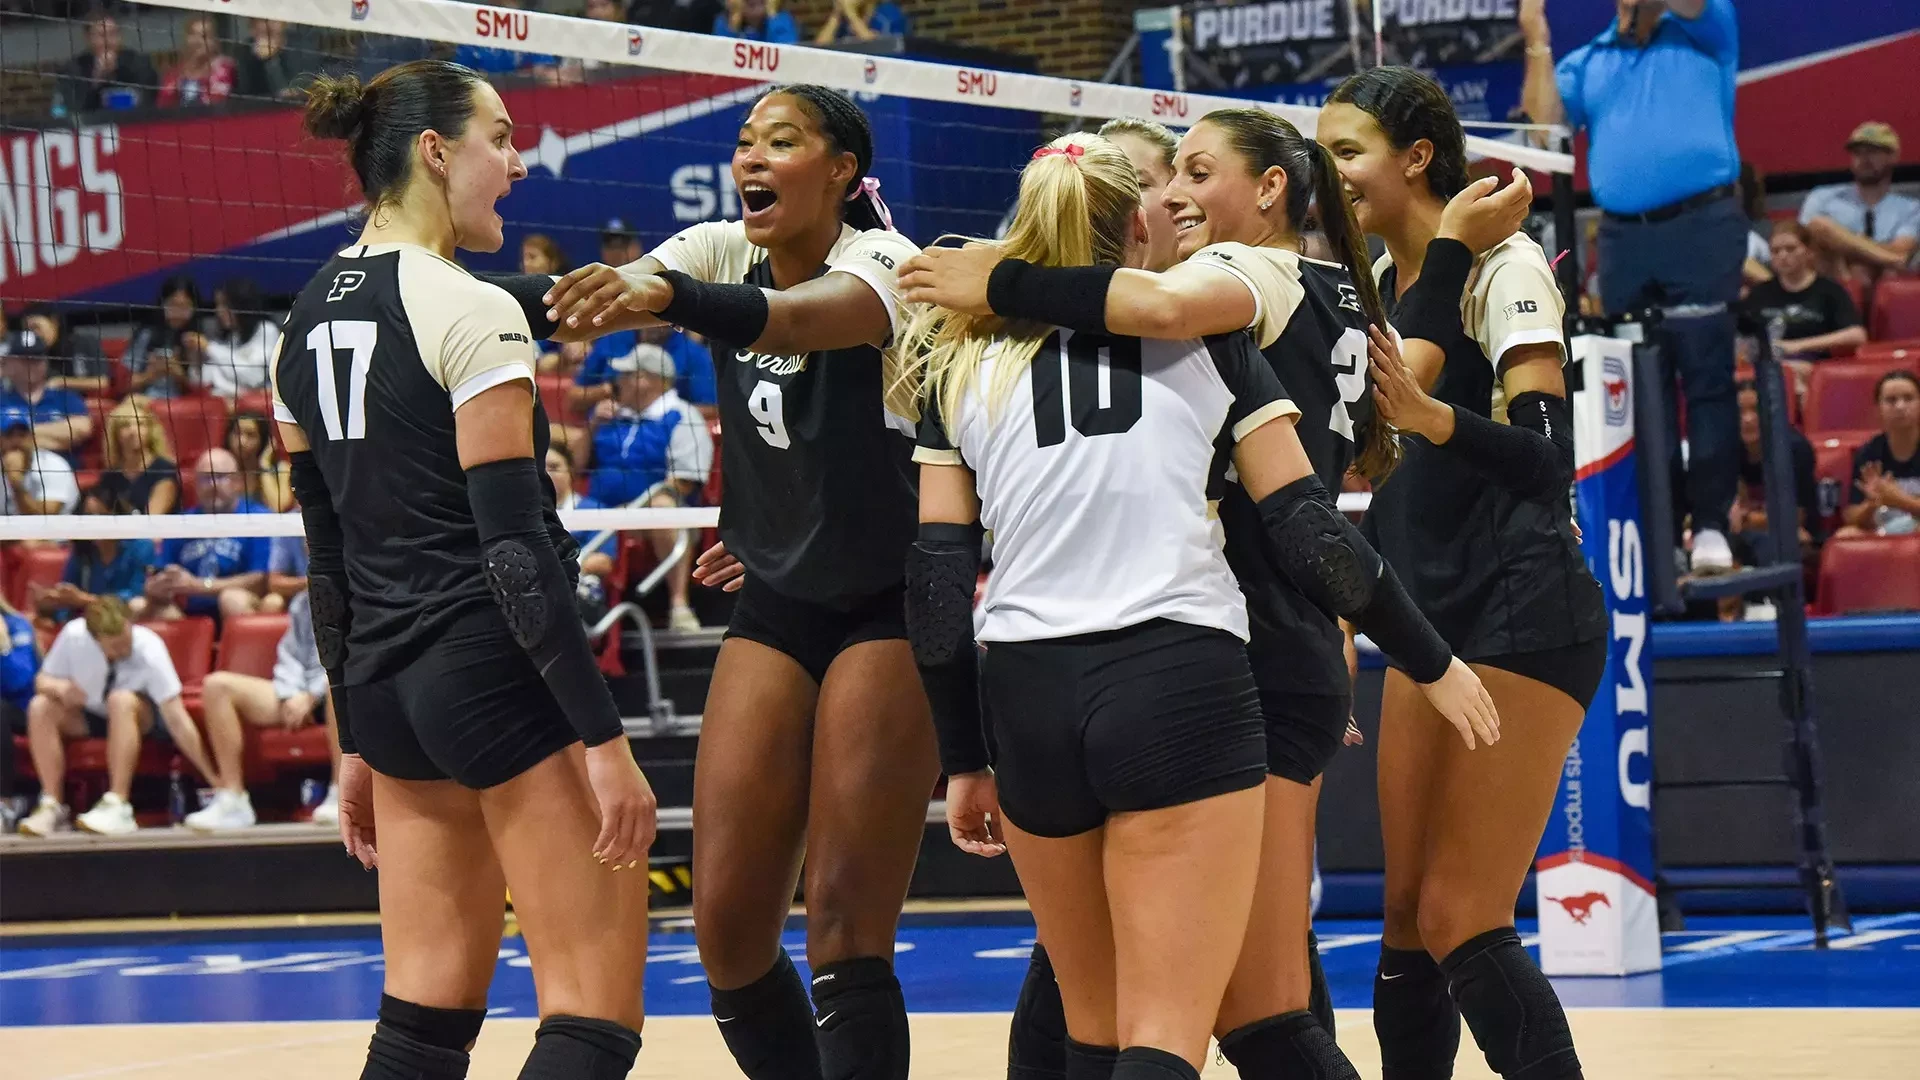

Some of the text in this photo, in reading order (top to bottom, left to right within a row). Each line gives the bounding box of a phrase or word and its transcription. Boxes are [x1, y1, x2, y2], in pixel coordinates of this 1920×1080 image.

[476, 8, 529, 41] SMU
[1195, 0, 1336, 49] PURDUE
[734, 42, 780, 72] SMU
[957, 70, 998, 97] SMU
[1152, 93, 1188, 118] SMU
[326, 270, 366, 303] P
[306, 320, 378, 441] 17
[1030, 329, 1143, 449] 10
[747, 379, 791, 450] 9
[1608, 518, 1651, 811] SMU
